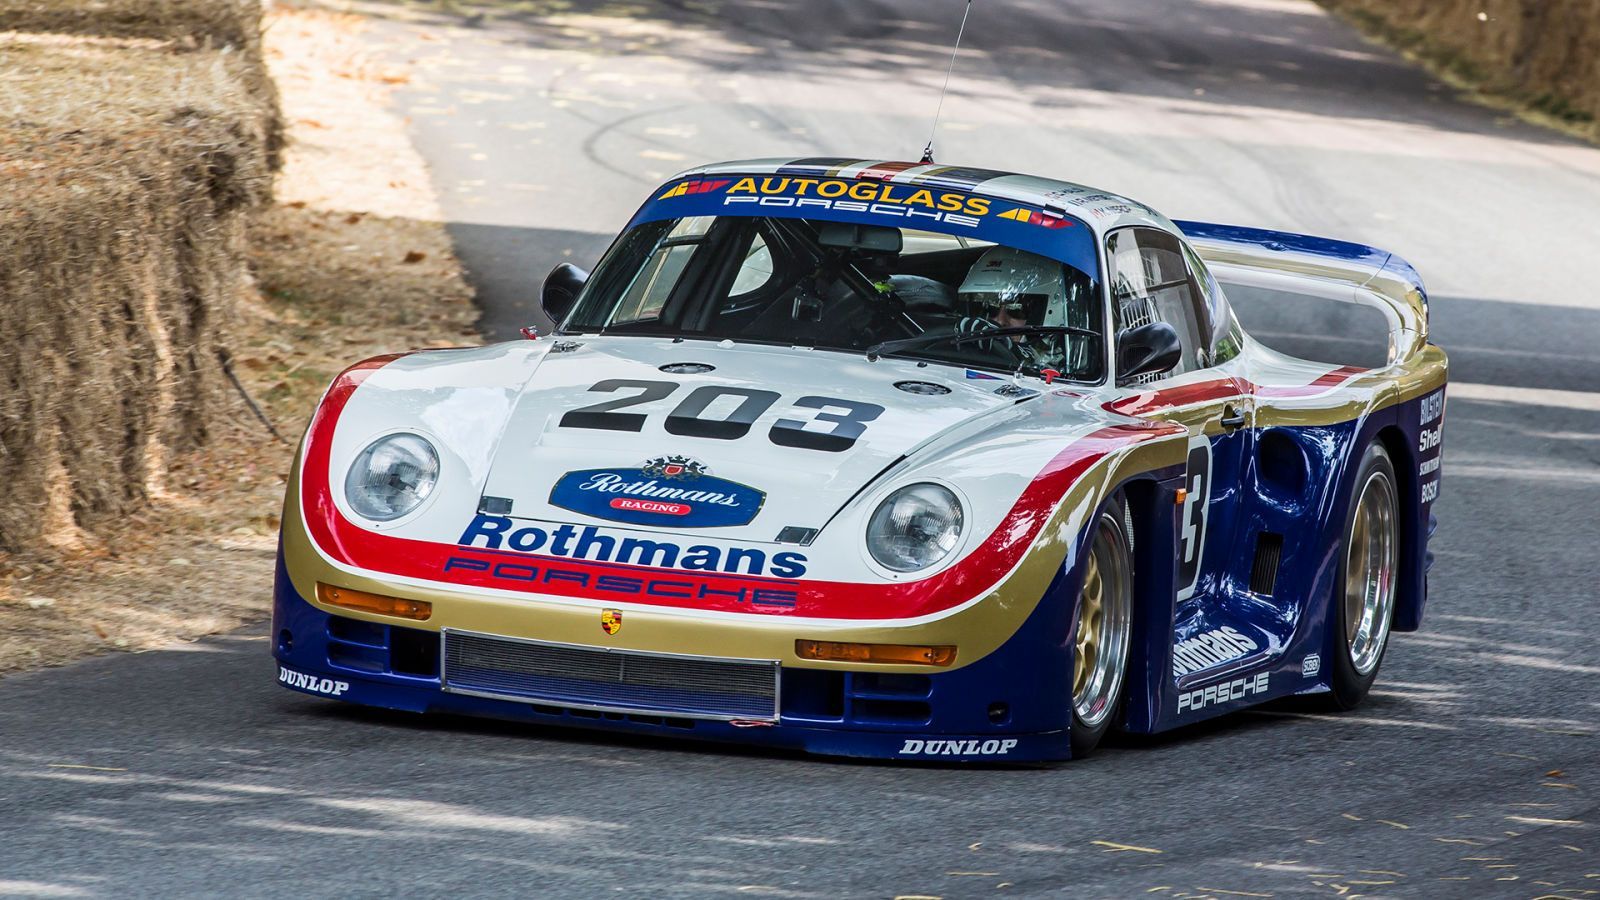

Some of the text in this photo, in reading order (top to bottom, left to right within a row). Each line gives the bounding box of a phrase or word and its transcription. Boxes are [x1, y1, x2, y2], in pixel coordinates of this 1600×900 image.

[723, 196, 980, 228] PORSCHE
[725, 177, 992, 216] AUTOGLASS
[559, 378, 886, 452] 203
[579, 472, 741, 507] Rothmans
[619, 500, 680, 514] RACING
[458, 514, 808, 578] Rothmans
[444, 556, 798, 607] PORSCHE
[279, 666, 349, 696] DUNLOP
[1177, 672, 1270, 714] PORSCHE
[899, 739, 1018, 755] DUNLOP
